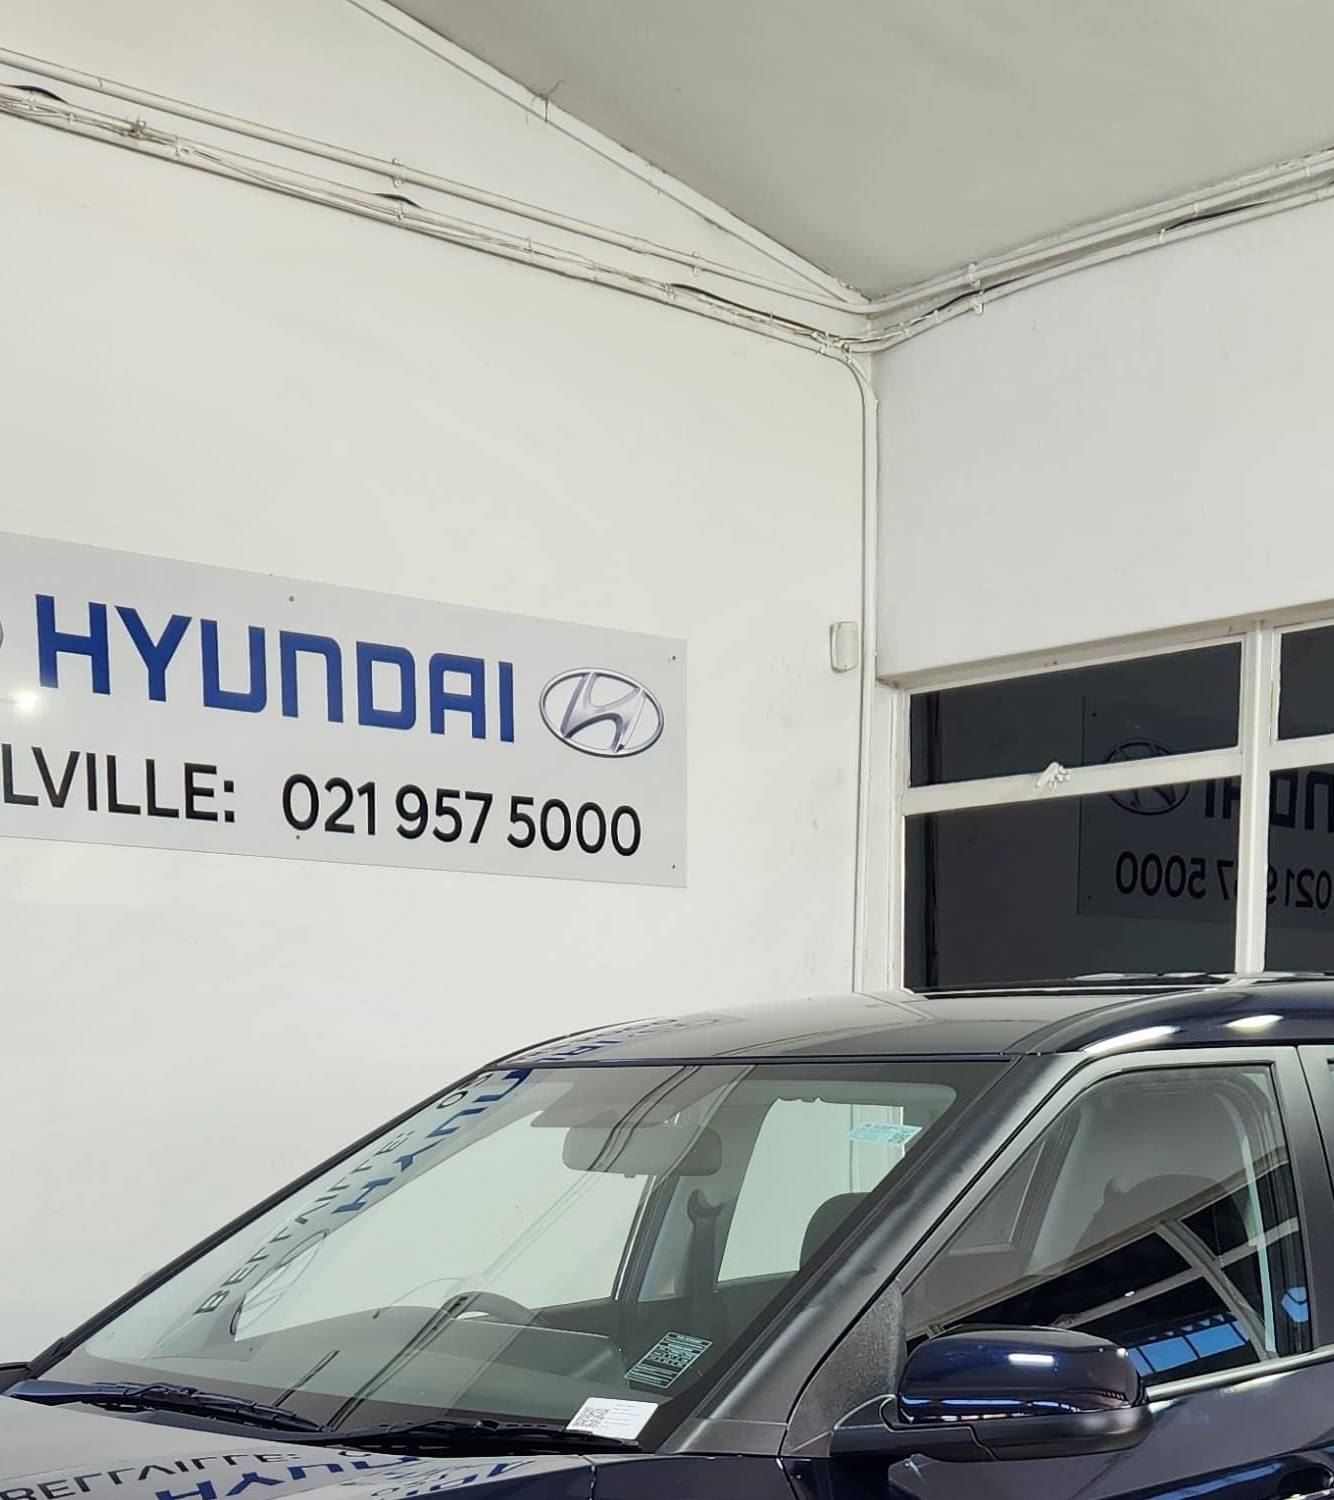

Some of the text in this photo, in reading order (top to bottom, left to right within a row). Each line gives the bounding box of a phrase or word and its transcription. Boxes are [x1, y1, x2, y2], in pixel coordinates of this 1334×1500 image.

[34, 592, 516, 743] HYUNDAI
[281, 772, 378, 837] 021
[395, 780, 494, 845] 957
[505, 795, 642, 857] 5000
